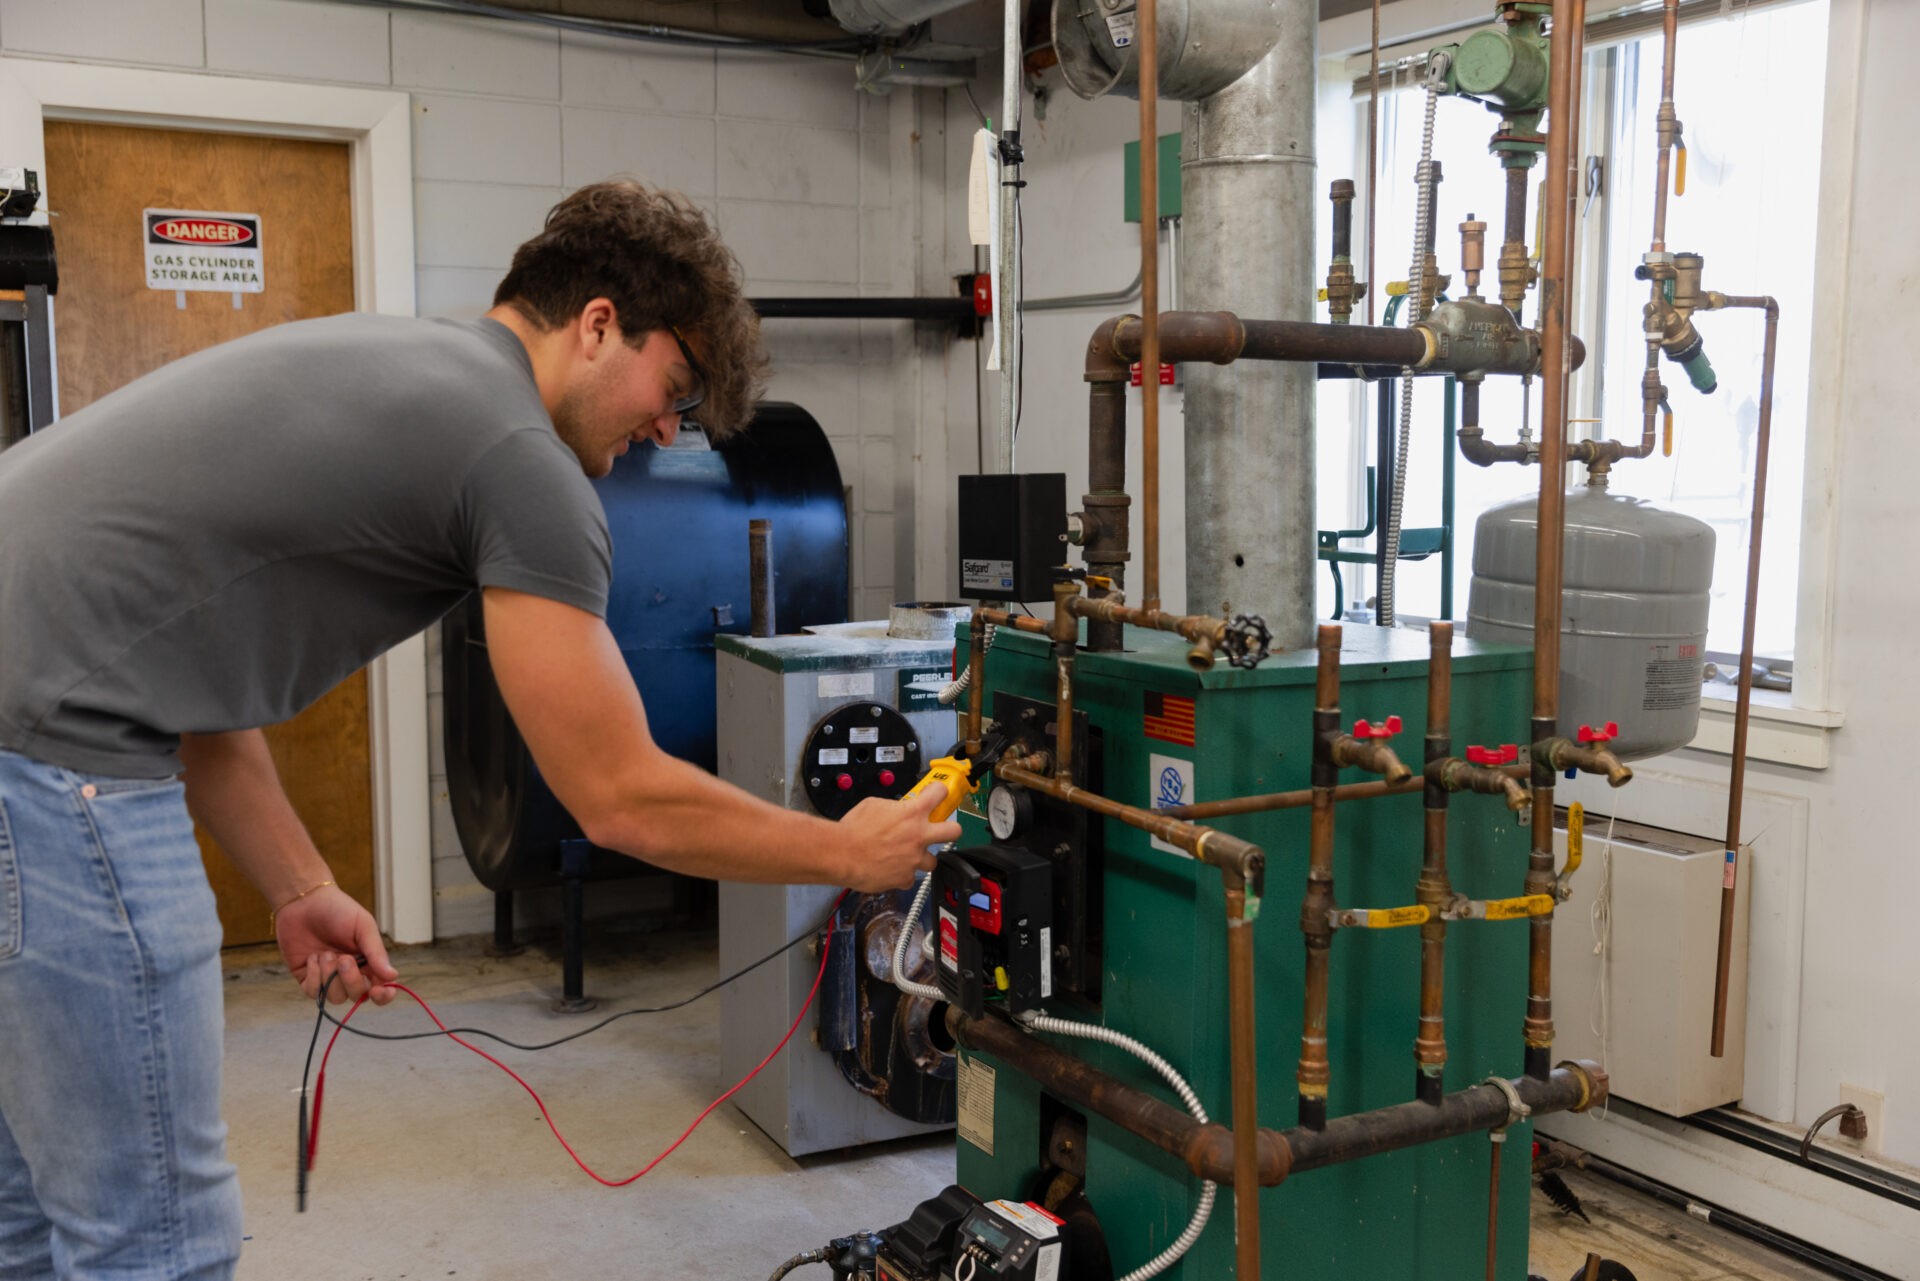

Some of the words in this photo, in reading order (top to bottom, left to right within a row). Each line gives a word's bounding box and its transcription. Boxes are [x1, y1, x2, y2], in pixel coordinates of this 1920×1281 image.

[166, 222, 239, 240] DANGER
[154, 255, 183, 265] GAS
[189, 256, 255, 268] CYLINDER
[152, 269, 217, 281] STORAGE
[223, 272, 259, 282] AREA
[912, 672, 952, 682] PEERLE
